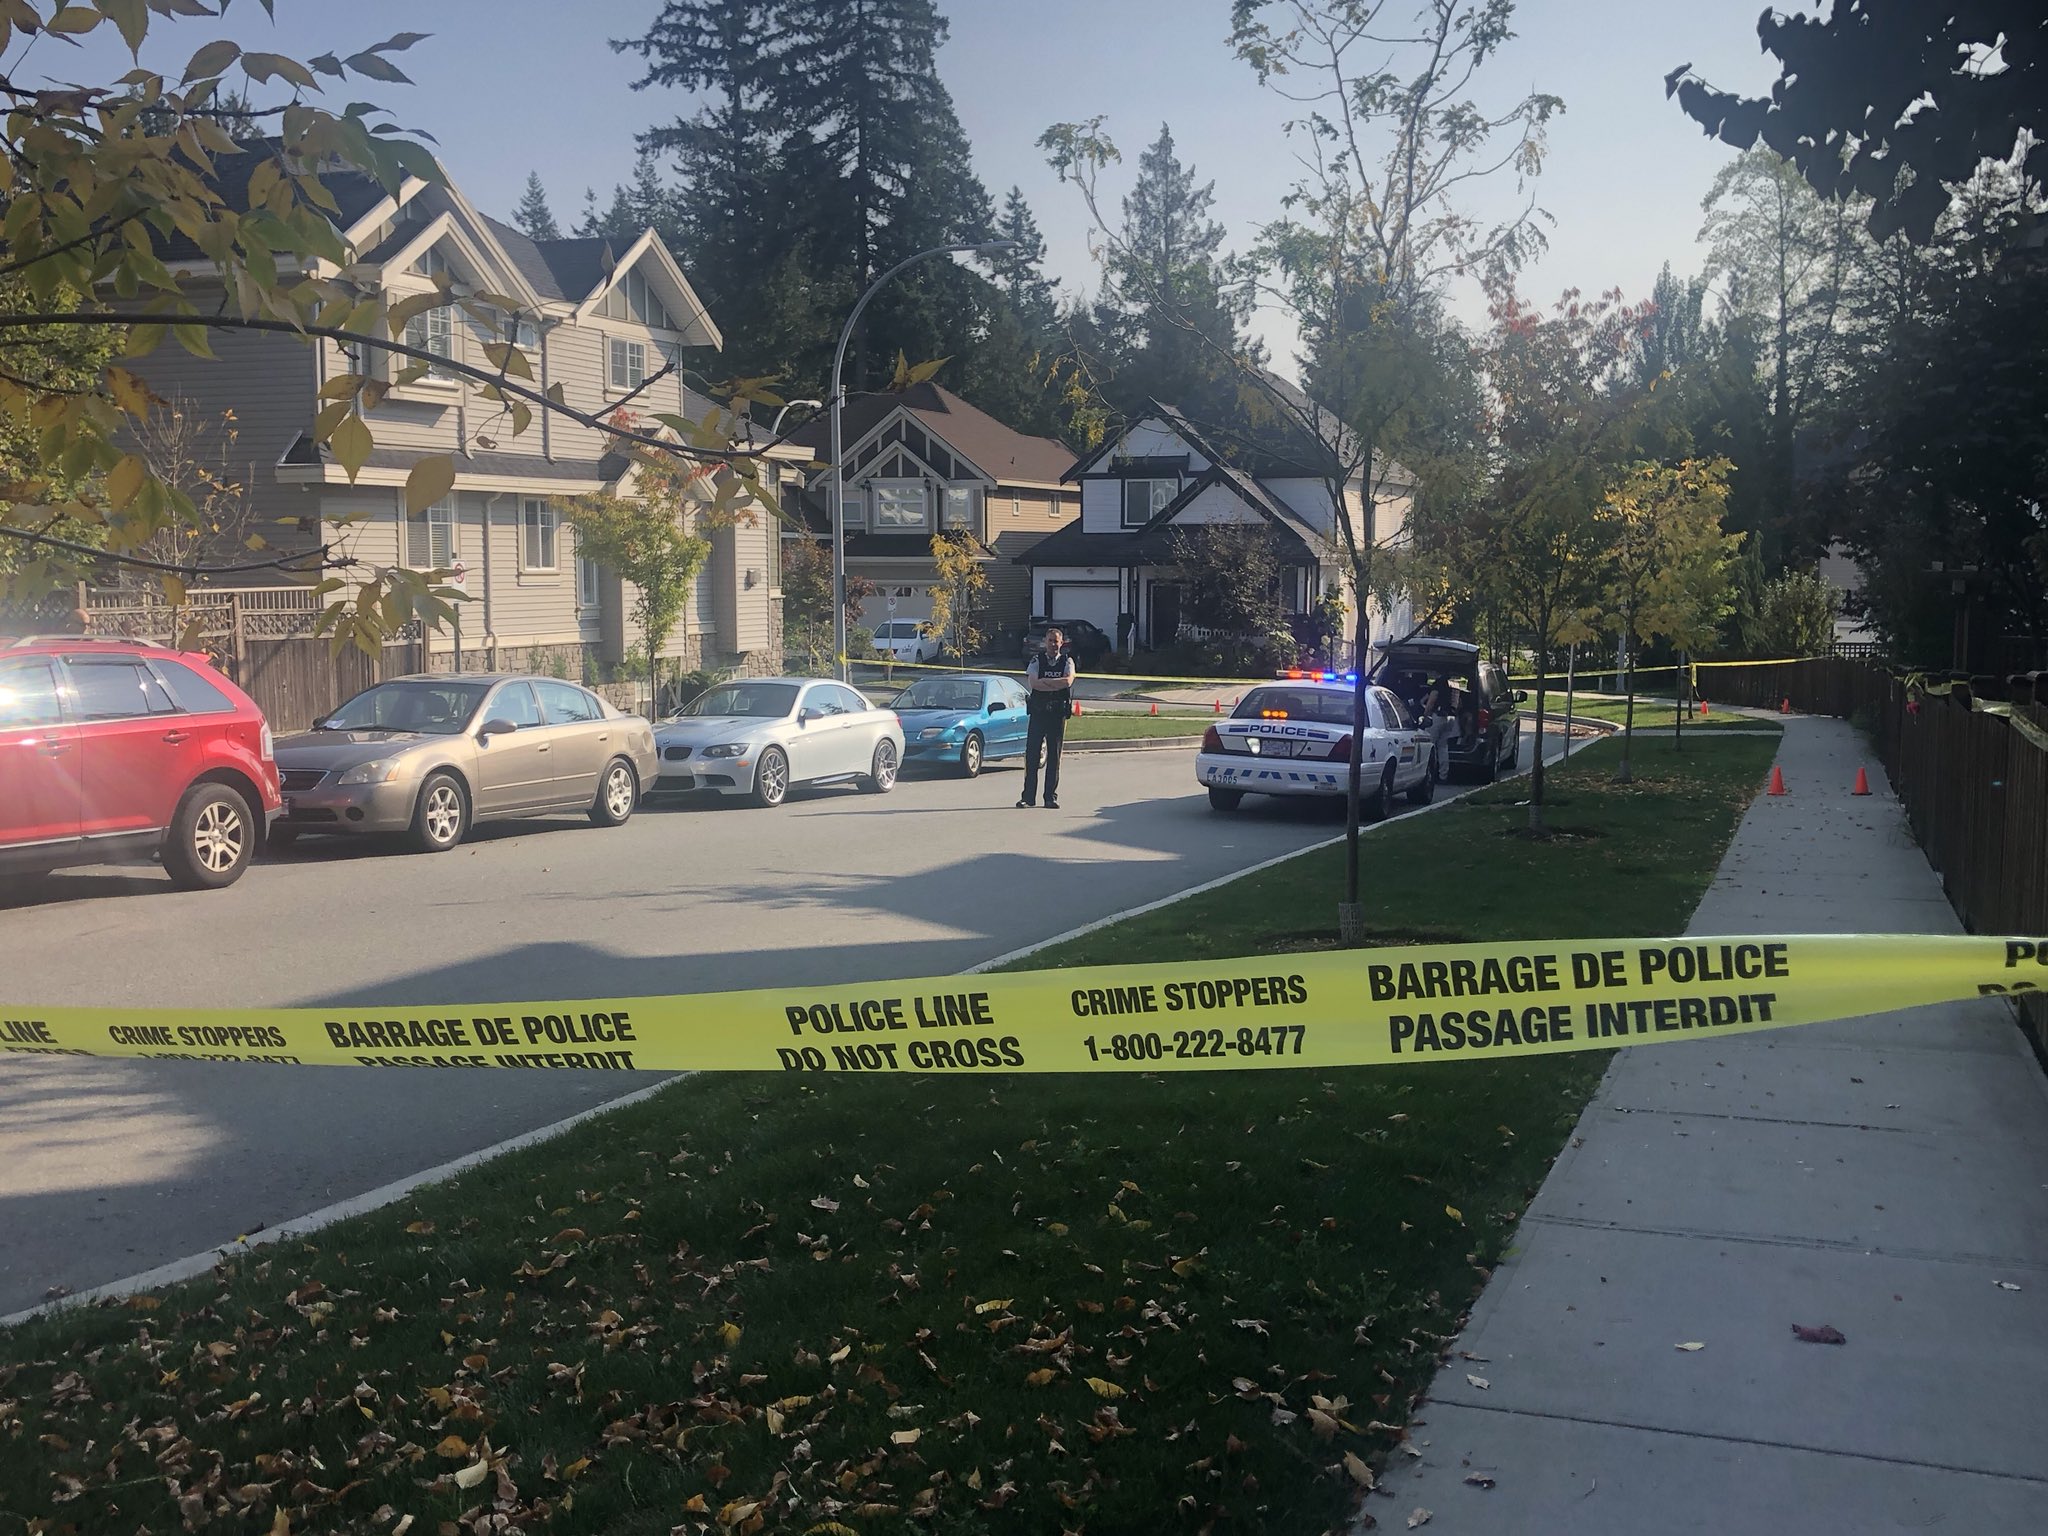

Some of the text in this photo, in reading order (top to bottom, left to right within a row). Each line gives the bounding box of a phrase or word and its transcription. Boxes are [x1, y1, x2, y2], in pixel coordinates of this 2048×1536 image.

[1249, 724, 1307, 737] POLICE
[1368, 943, 1789, 1001] BARRAGE DE POLICE
[785, 992, 994, 1035] POLICE LINE
[1071, 974, 1308, 1017] CRIME STOPPERS
[108, 1025, 287, 1047] CRIME STOPPERS
[324, 1012, 637, 1048] BARRAGE DE POLICE
[1389, 993, 1776, 1054] PASSAGE INTERDIT
[776, 1036, 1025, 1071] DO NOT CROSS
[1084, 1025, 1306, 1061] 1-800-222-8477
